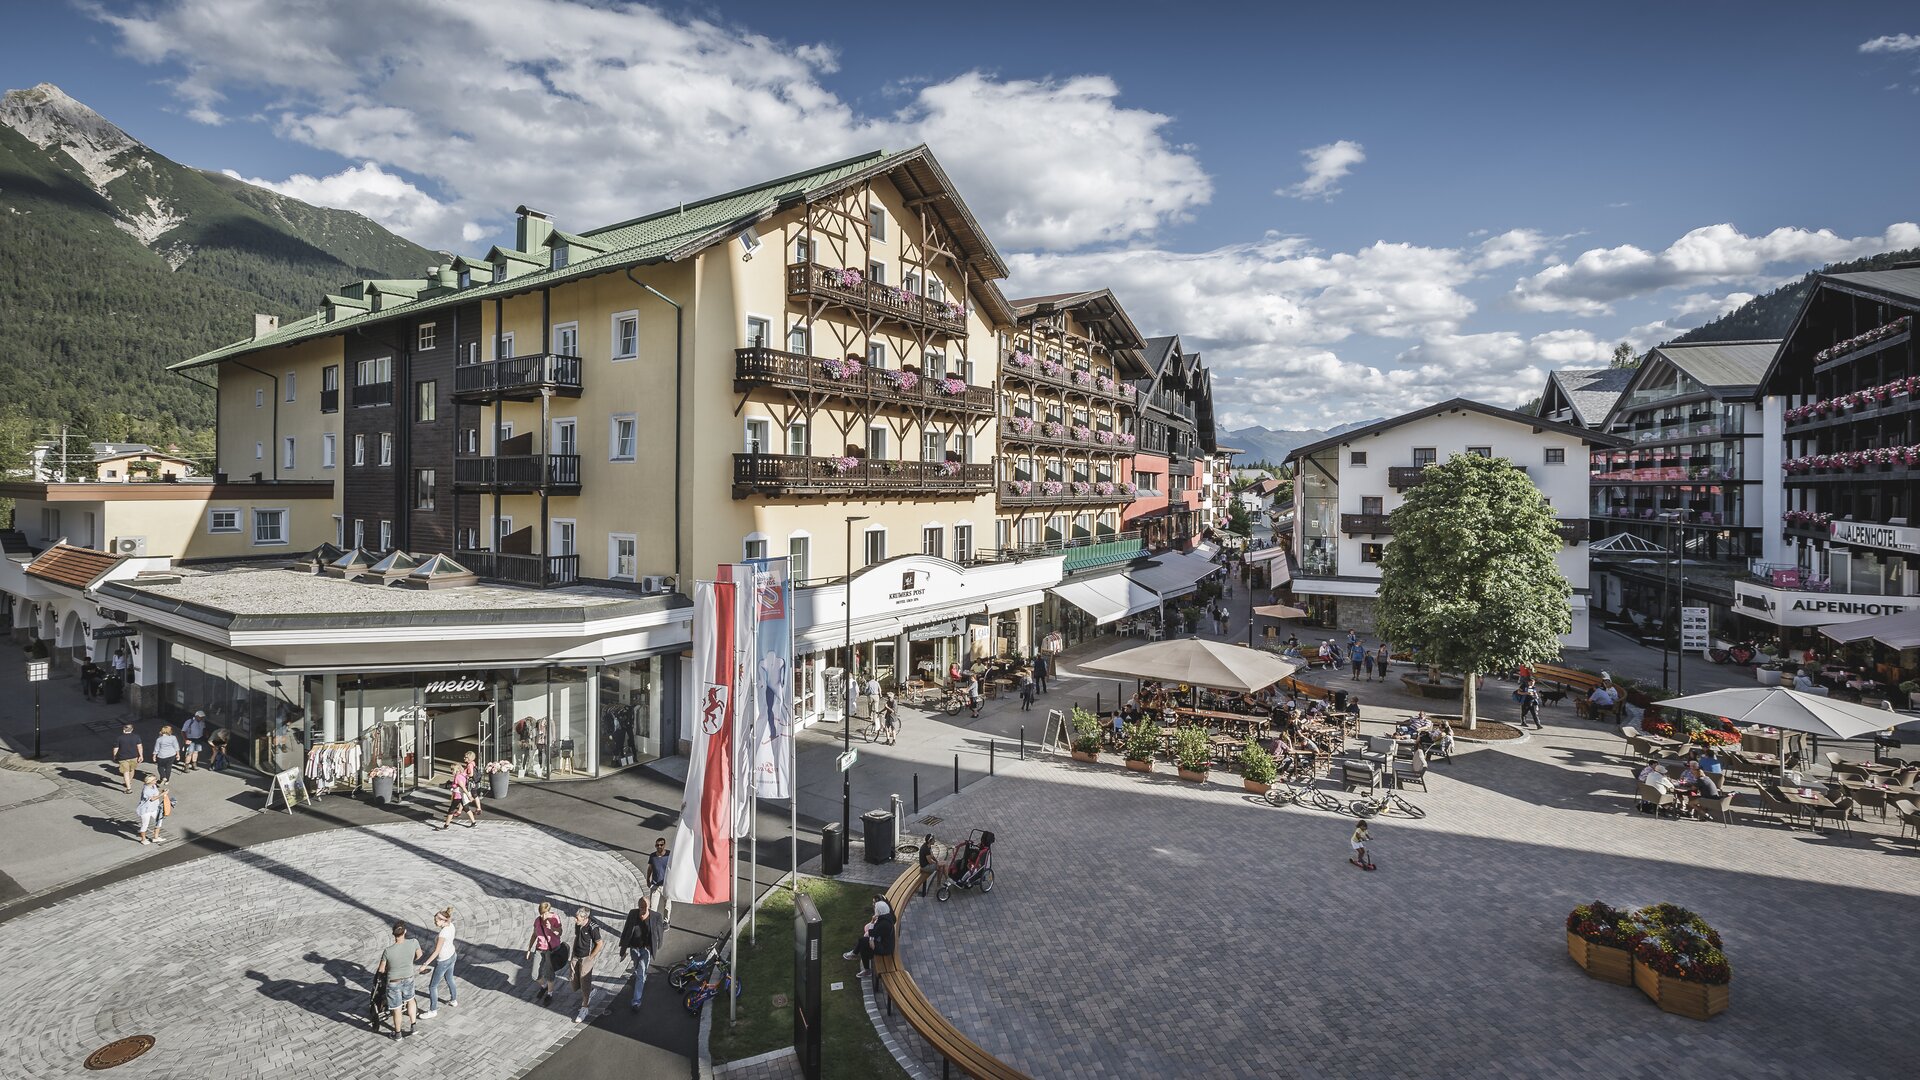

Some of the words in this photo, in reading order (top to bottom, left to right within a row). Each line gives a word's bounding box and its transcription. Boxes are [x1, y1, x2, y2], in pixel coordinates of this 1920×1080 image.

[1847, 525, 1898, 548] ALPENHOTEL
[1793, 600, 1908, 616] ALPENHOTE
[425, 676, 485, 693] meier
